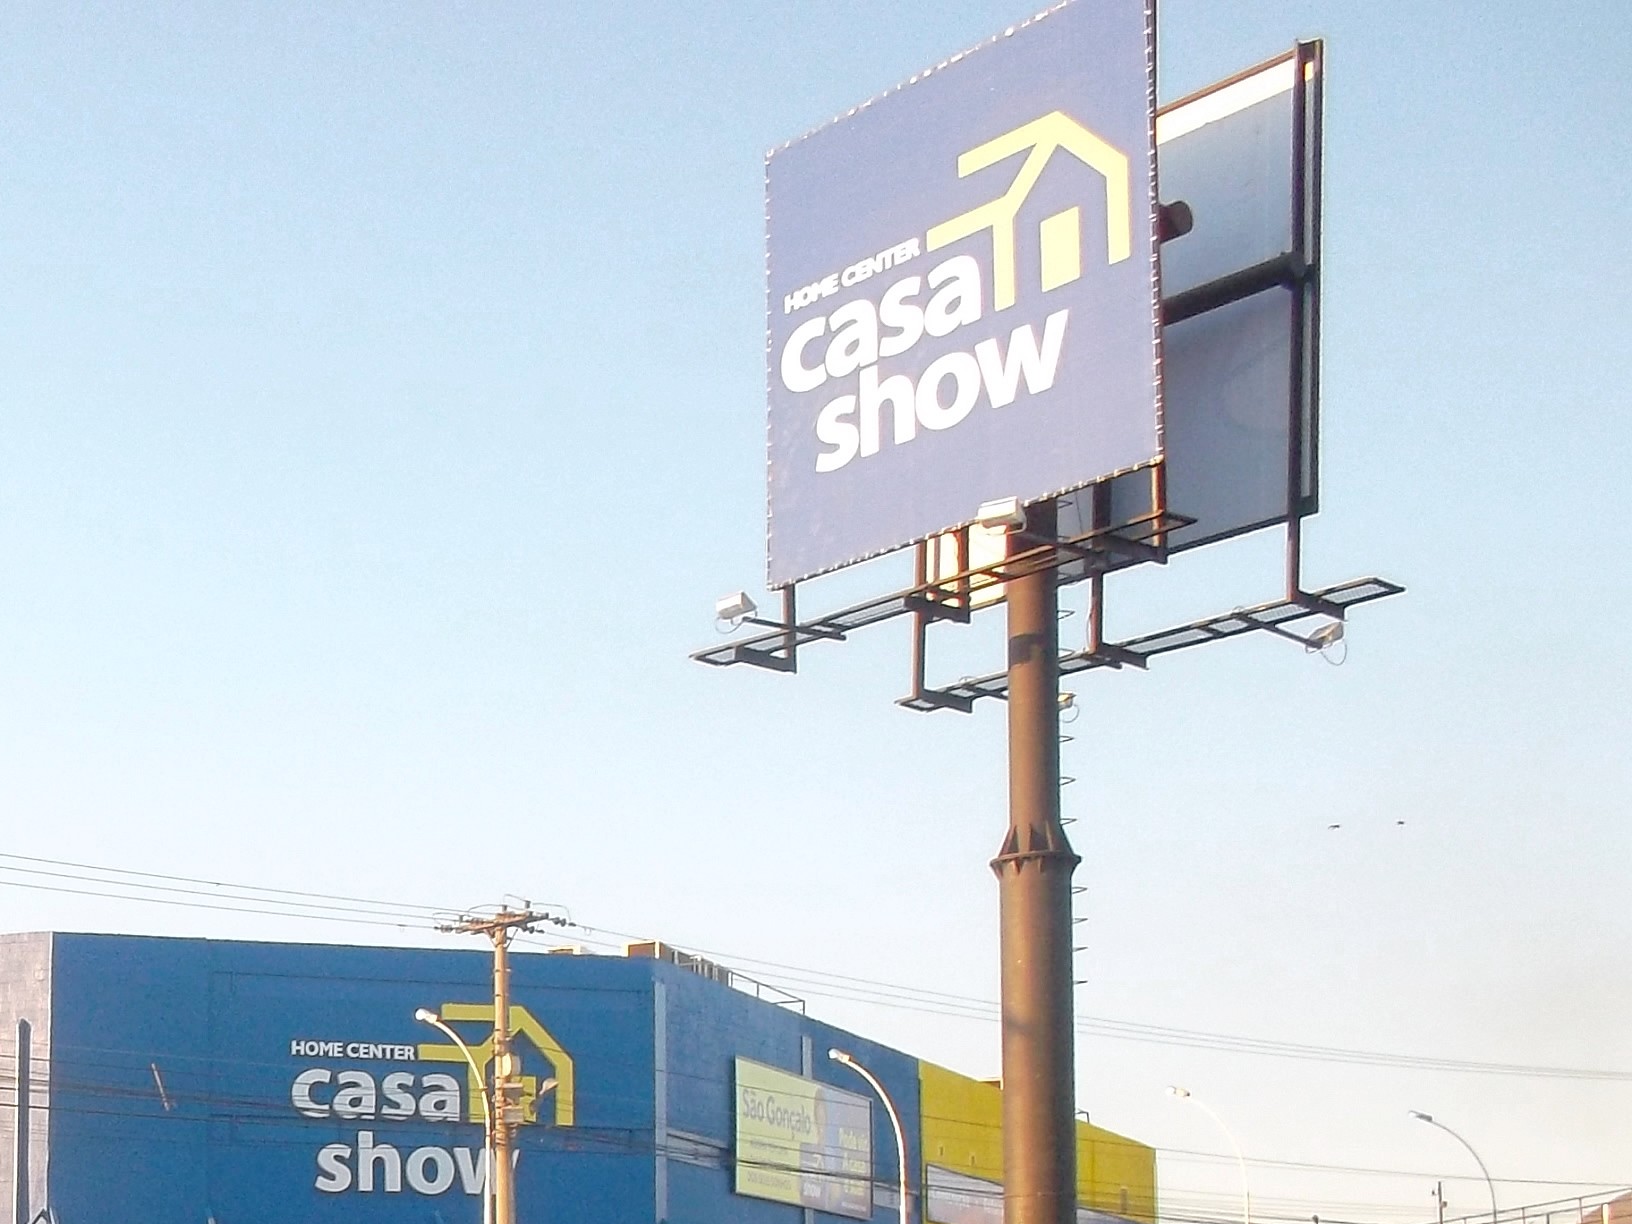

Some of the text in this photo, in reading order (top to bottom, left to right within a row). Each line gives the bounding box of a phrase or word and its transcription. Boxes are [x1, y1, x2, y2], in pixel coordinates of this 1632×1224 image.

[783, 237, 920, 314] HOME CENTER
[780, 255, 982, 393] casa
[815, 308, 1069, 473] show
[290, 1040, 415, 1061] HOME CENTER
[291, 1068, 460, 1122] casa
